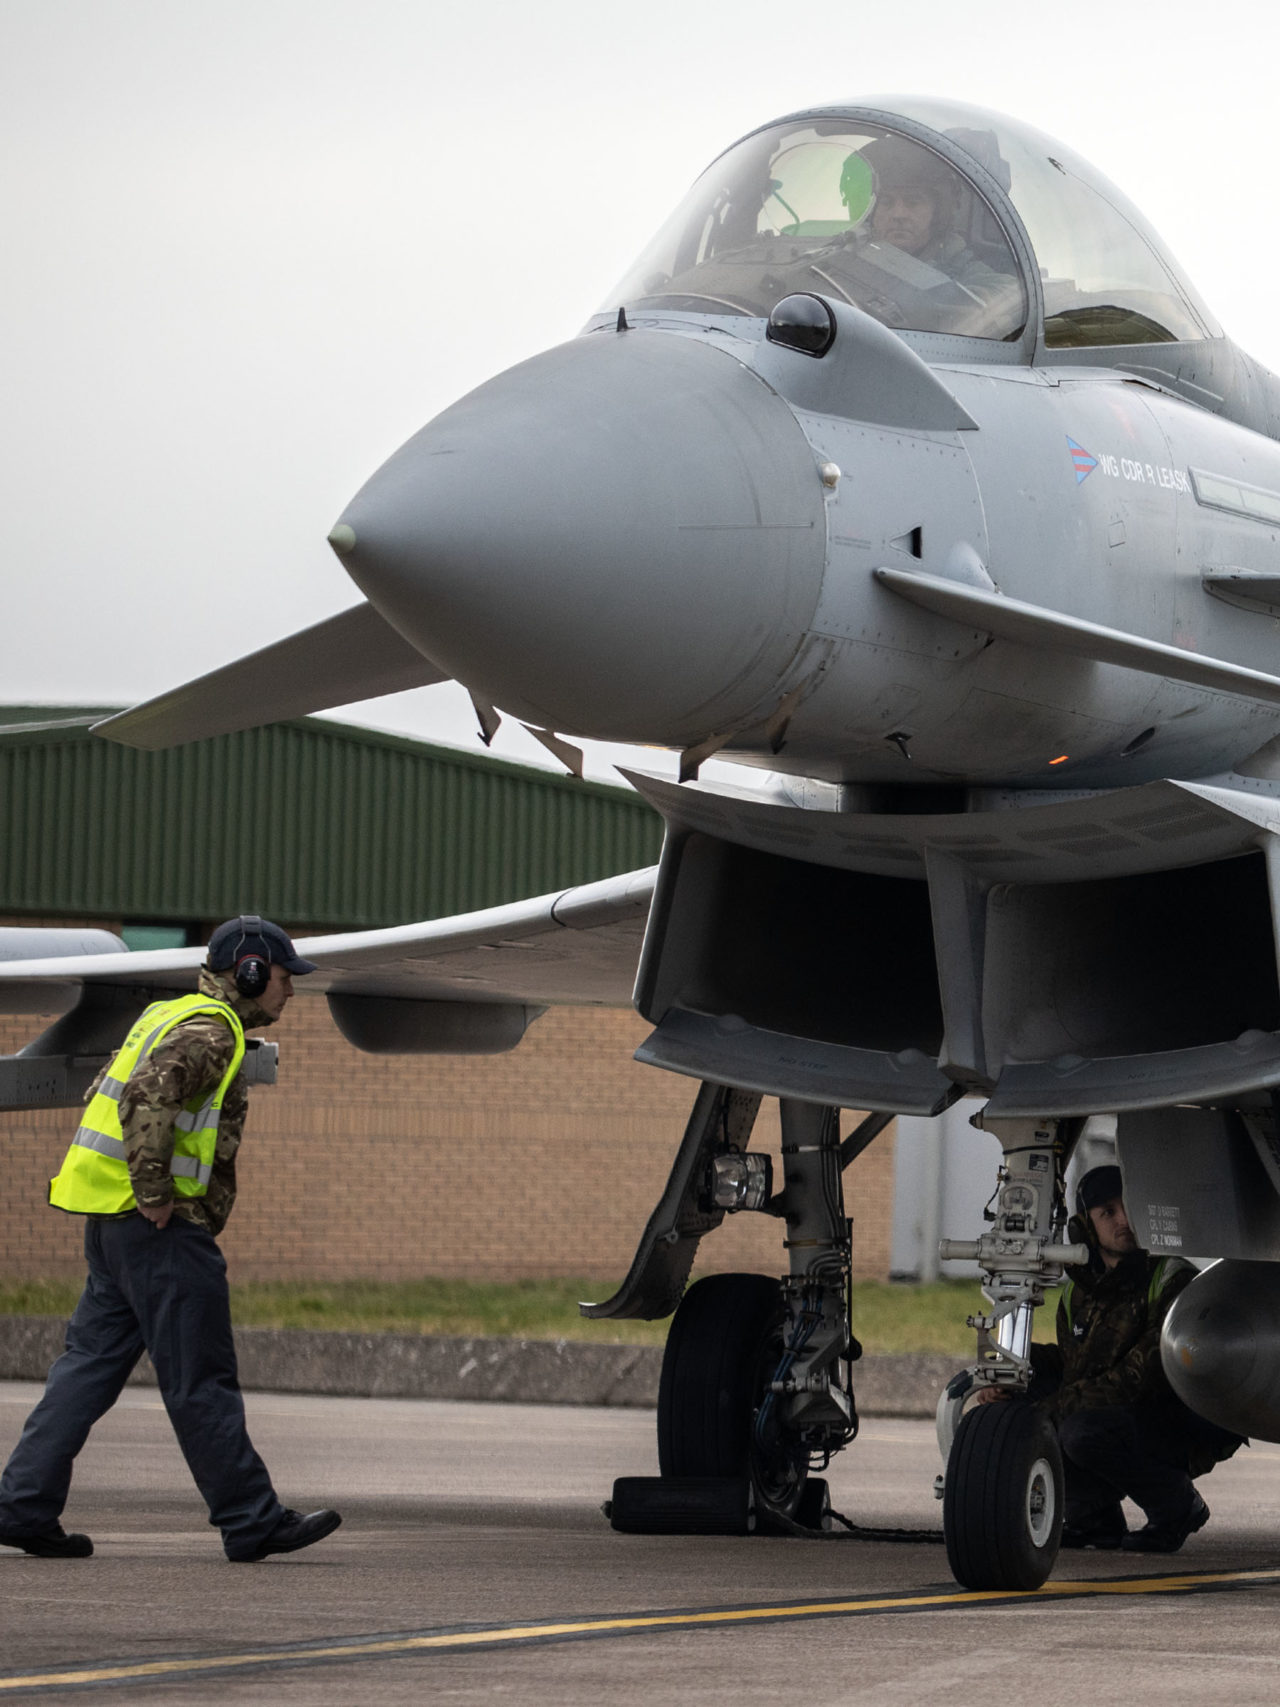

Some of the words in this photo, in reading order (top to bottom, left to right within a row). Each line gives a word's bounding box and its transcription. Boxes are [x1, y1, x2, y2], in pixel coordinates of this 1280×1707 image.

[1098, 453, 1119, 478] WG
[1120, 457, 1146, 483] CDR
[1145, 463, 1157, 486] R
[1156, 465, 1191, 493] LEASK
[1151, 1233, 1160, 1246] CPL
